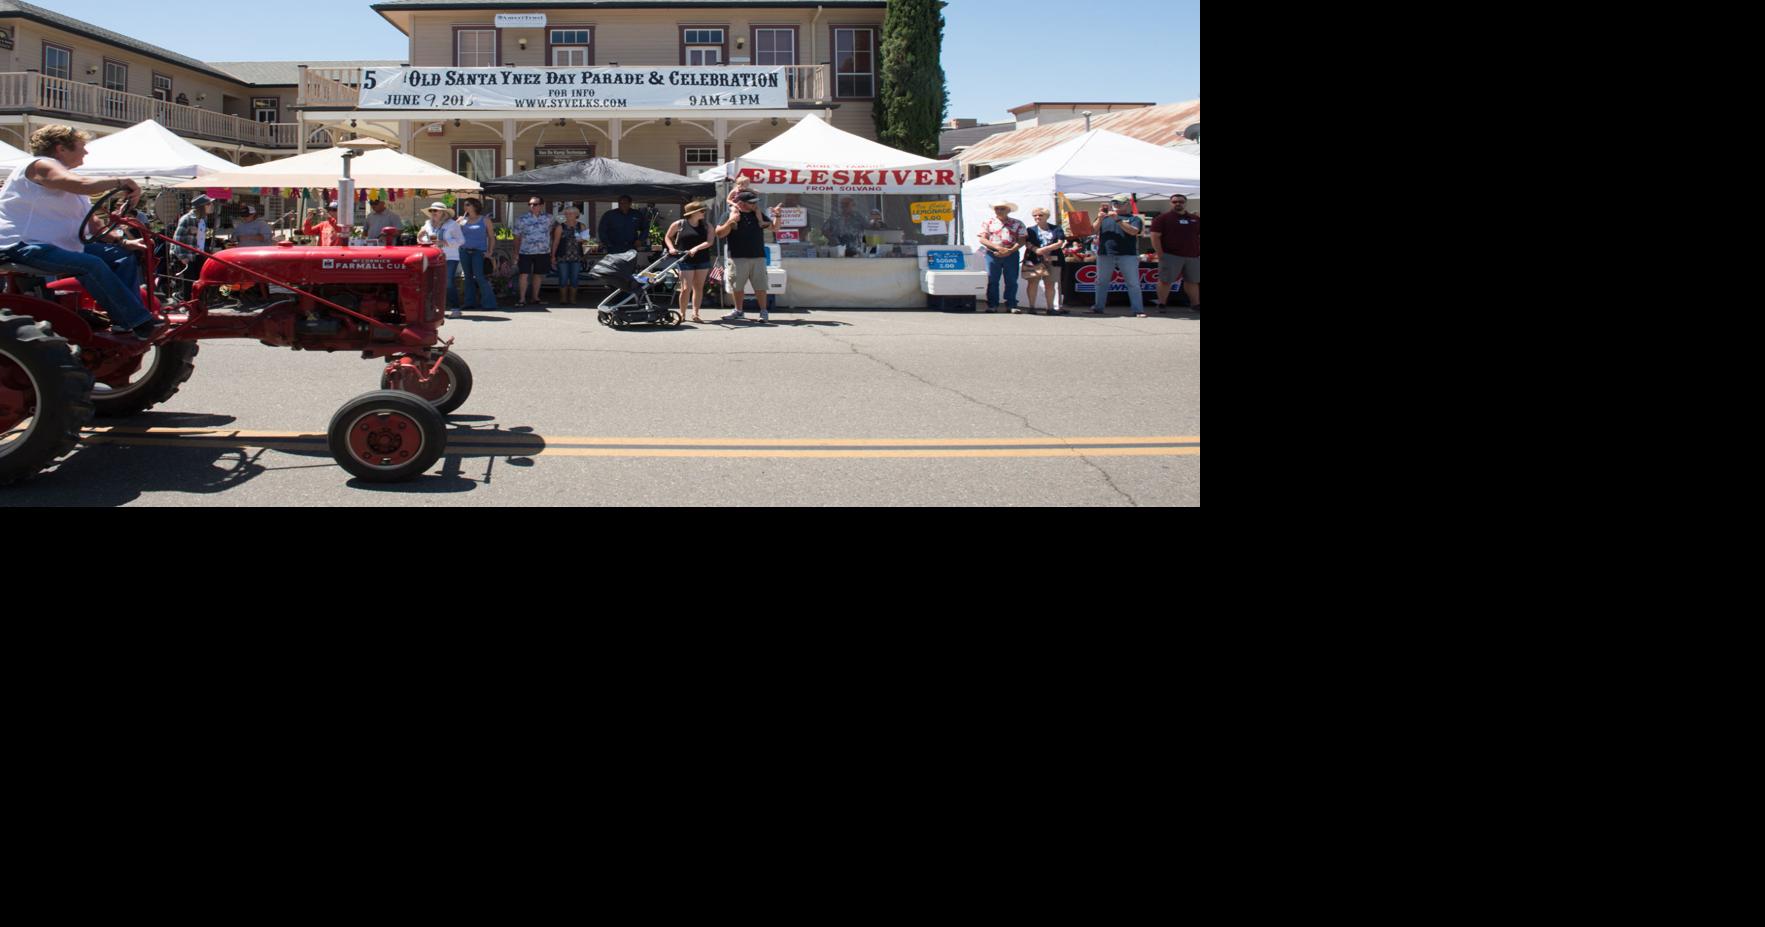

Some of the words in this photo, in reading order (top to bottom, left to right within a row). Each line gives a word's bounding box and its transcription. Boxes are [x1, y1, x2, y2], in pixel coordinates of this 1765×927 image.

[363, 70, 377, 90] 5
[409, 70, 441, 87] OLD
[444, 70, 498, 86] SANTA
[500, 71, 542, 85] YNEZ
[545, 71, 577, 85] DAY
[581, 71, 645, 85] PARADE
[648, 71, 665, 85] &
[669, 70, 779, 88] CELEBRATION
[548, 89, 568, 97] FOR
[571, 89, 595, 97] INFO
[384, 94, 420, 105] JUNE
[515, 99, 627, 108] WWW.SYVELKS.COM
